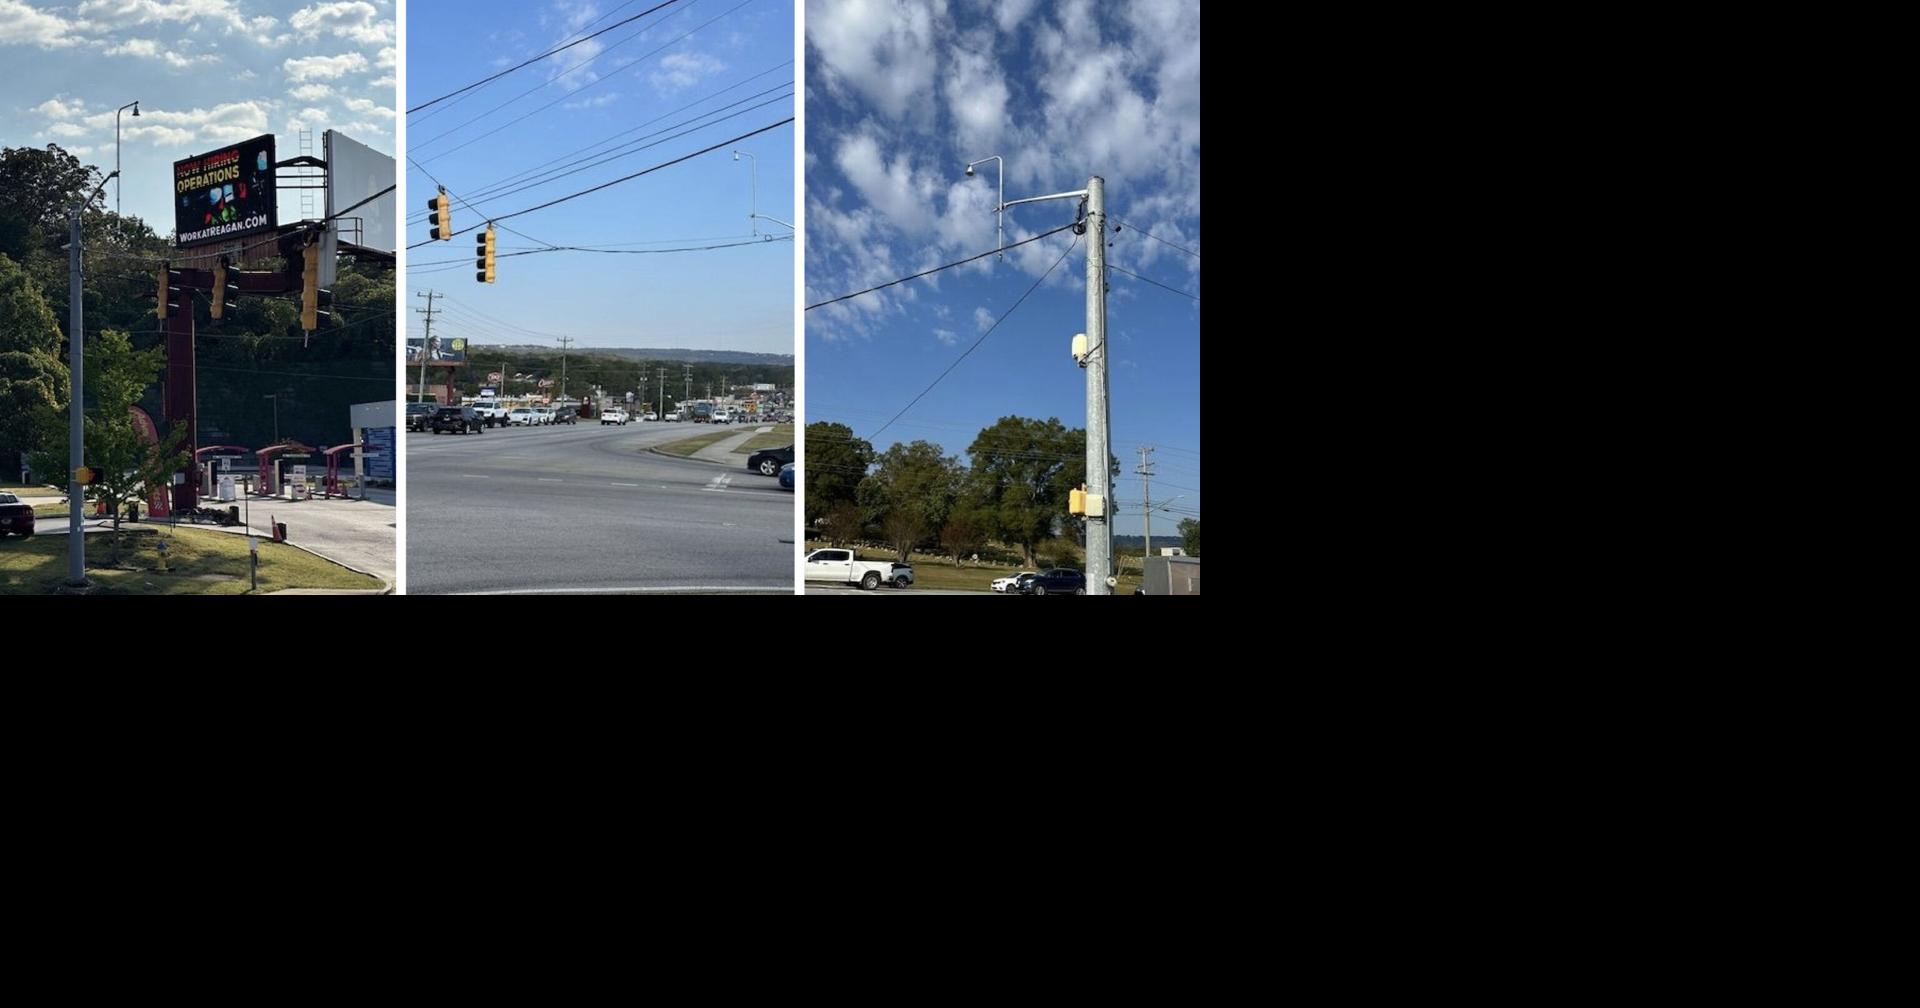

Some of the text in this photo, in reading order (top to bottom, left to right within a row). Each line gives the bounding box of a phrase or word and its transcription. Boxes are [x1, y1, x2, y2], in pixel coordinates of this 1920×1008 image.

[203, 149, 240, 171] HIRING
[177, 165, 239, 193] OPERATIONS
[180, 214, 267, 243] WORKATREAGAN.COM
